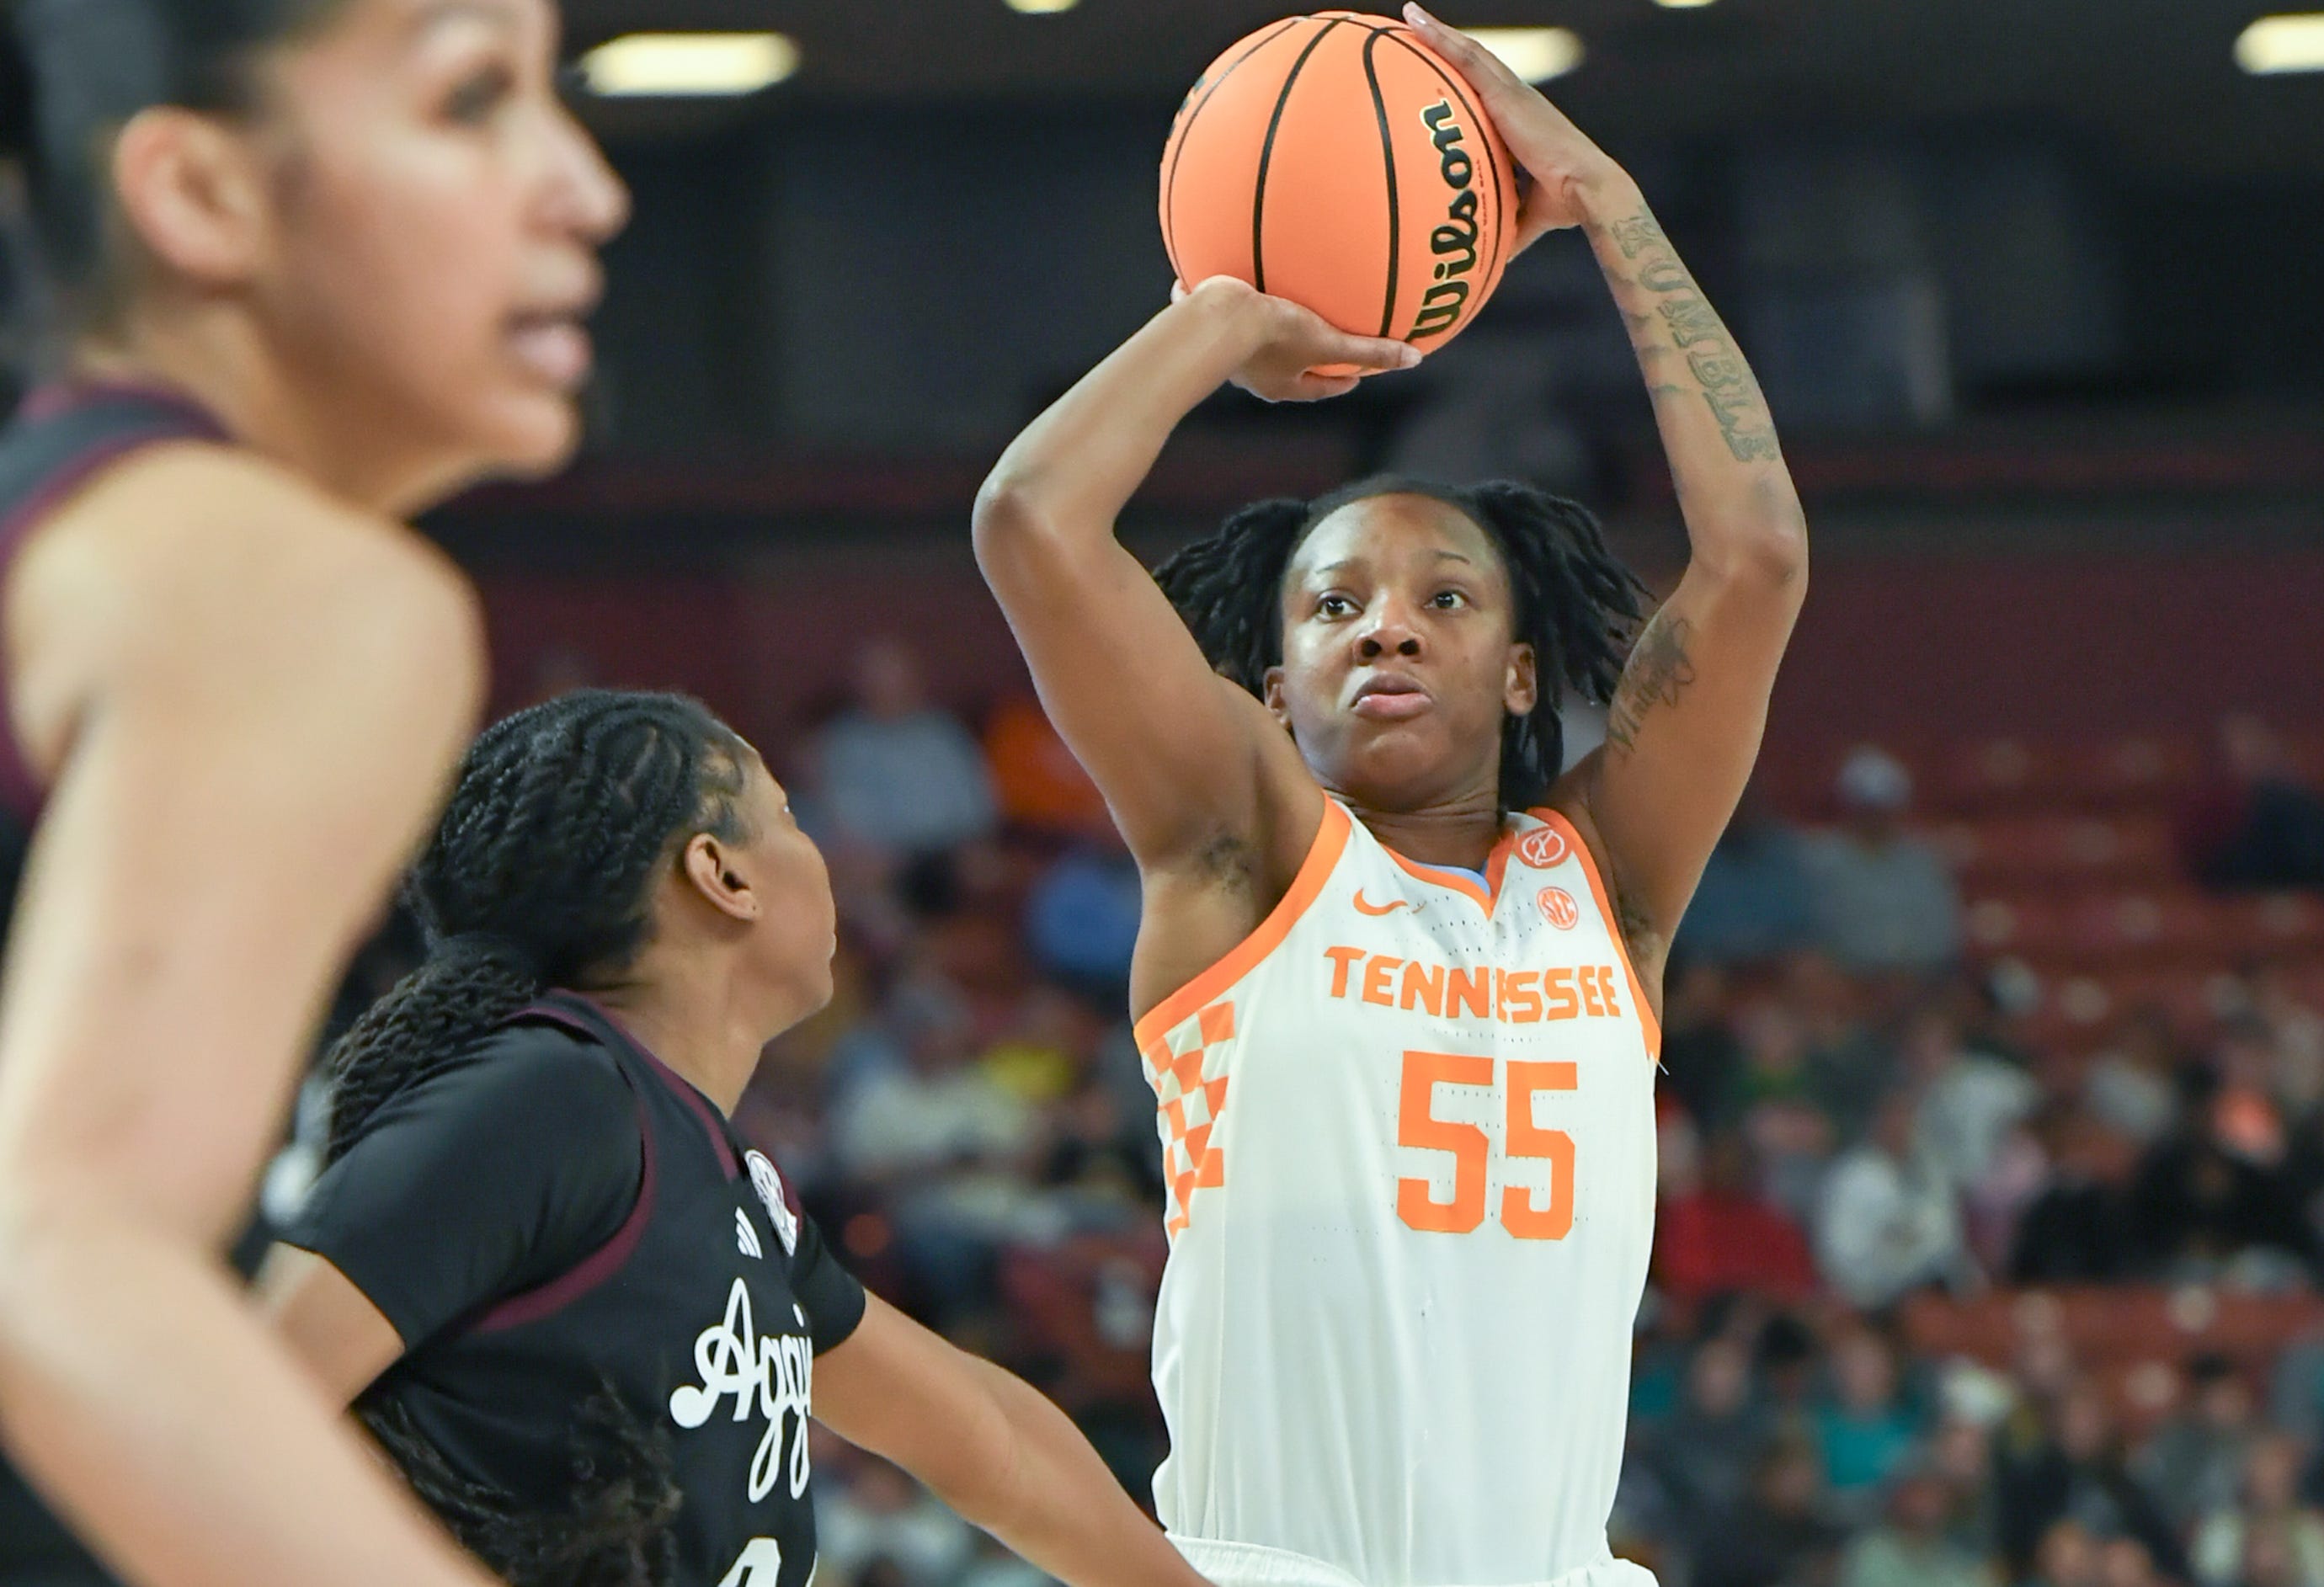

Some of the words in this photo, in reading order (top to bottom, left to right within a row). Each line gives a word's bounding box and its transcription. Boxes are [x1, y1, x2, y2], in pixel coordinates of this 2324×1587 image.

[1405, 99, 1479, 342] Wilson
[1324, 946, 1621, 1024] TENNESSEE
[1396, 1050, 1578, 1240] 55
